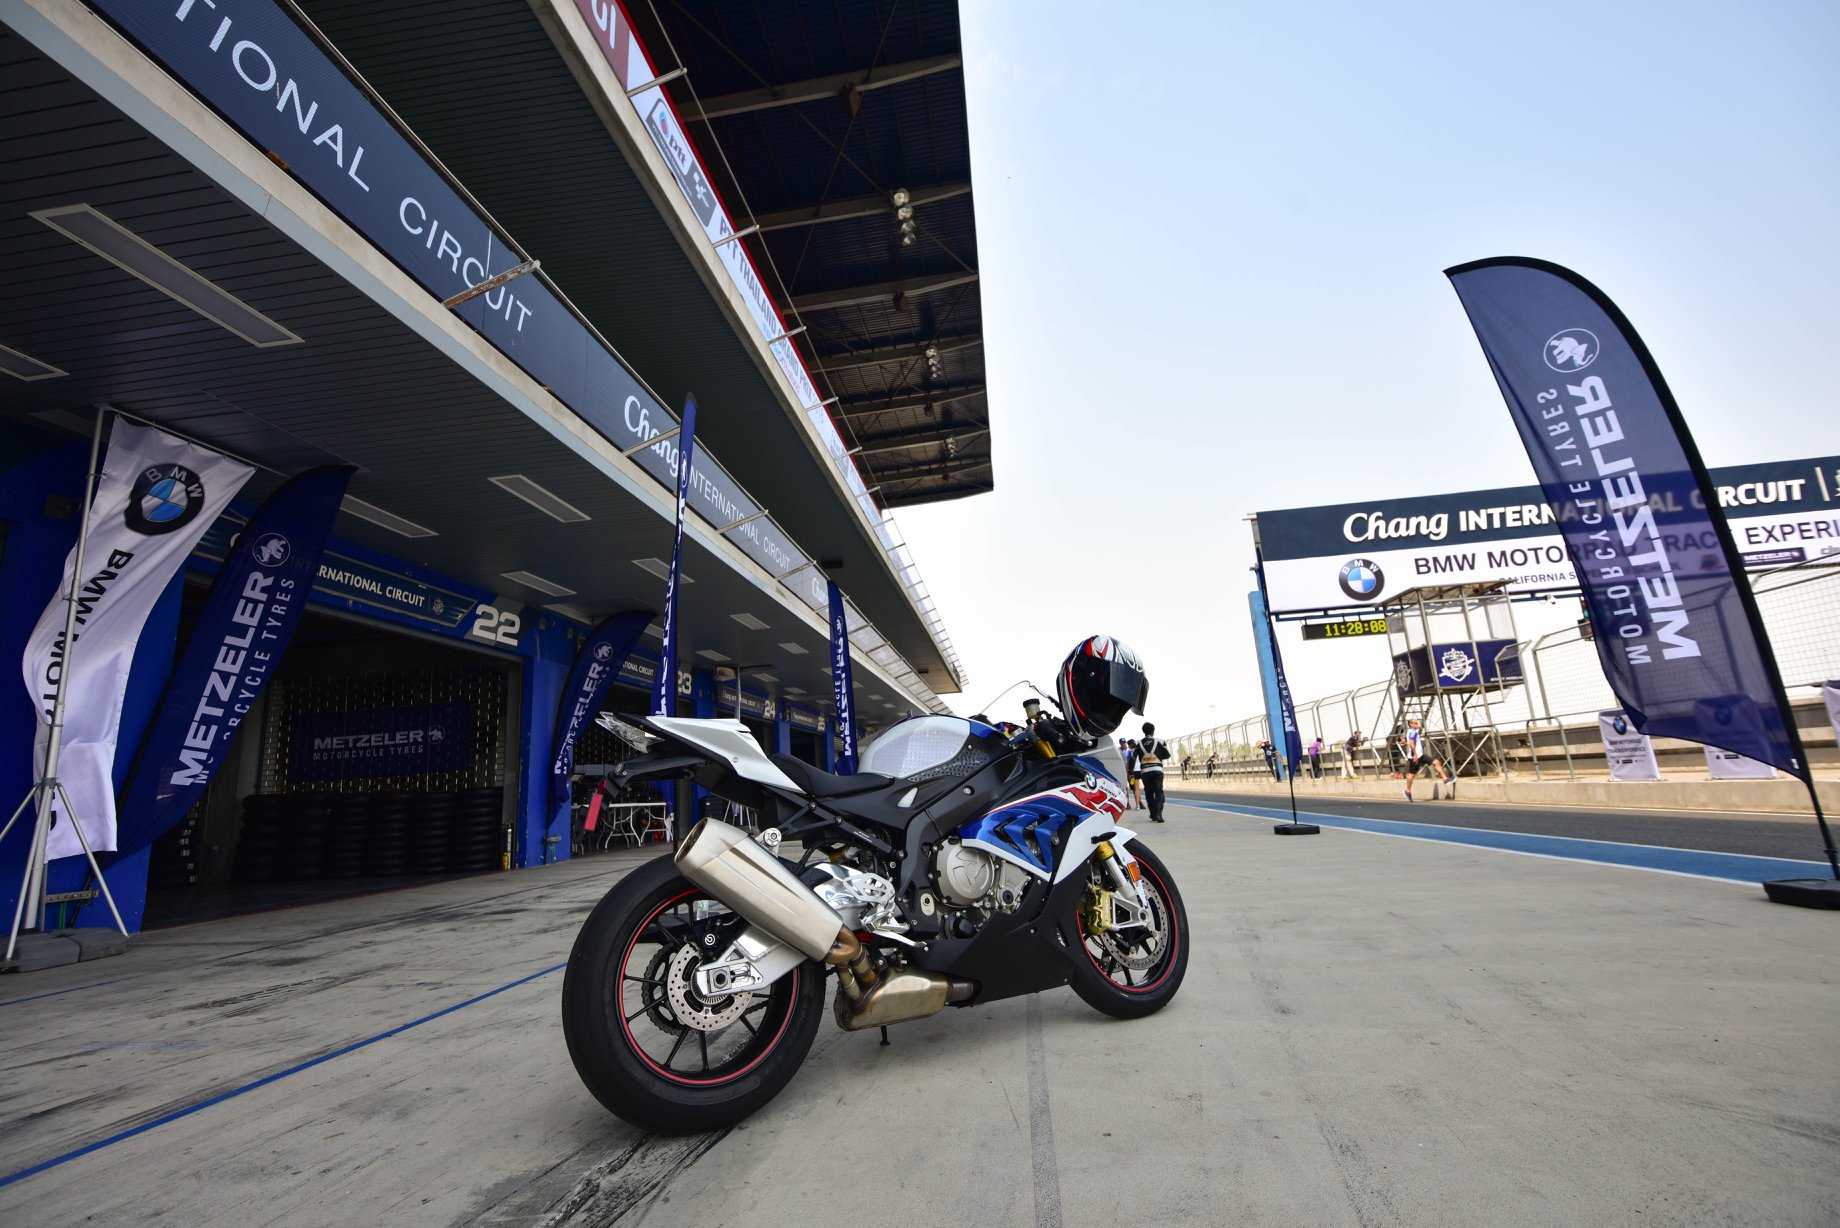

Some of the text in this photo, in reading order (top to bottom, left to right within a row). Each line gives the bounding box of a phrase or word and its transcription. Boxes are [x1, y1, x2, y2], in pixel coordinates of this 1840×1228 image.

[400, 197, 532, 332] CIRCUIT
[739, 252, 777, 335] THAILAND
[145, 466, 203, 499] BMW
[624, 395, 680, 478] Chang
[689, 465, 760, 546] NTERNATIONAL
[763, 536, 791, 570] CIRCUIT
[1343, 478, 1806, 543] Chang INTERNATIOAL CRCUIT
[1341, 559, 1380, 574] BMW
[1414, 552, 1476, 575] BMW
[1645, 528, 1738, 556] TRAC
[74, 549, 135, 626] BMW
[385, 586, 425, 608] CIRCUIT
[1499, 572, 1566, 585] LIFORNIA
[472, 603, 521, 647] 22
[1325, 619, 1387, 637] 11:28:08
[170, 570, 275, 787] METZELER
[193, 578, 295, 785] MRCYCLE TYRES
[554, 662, 604, 775] MZELER
[764, 699, 776, 719] 24
[313, 745, 424, 761] MOTORCYCLE TYRES
[314, 729, 424, 750] METZELER
